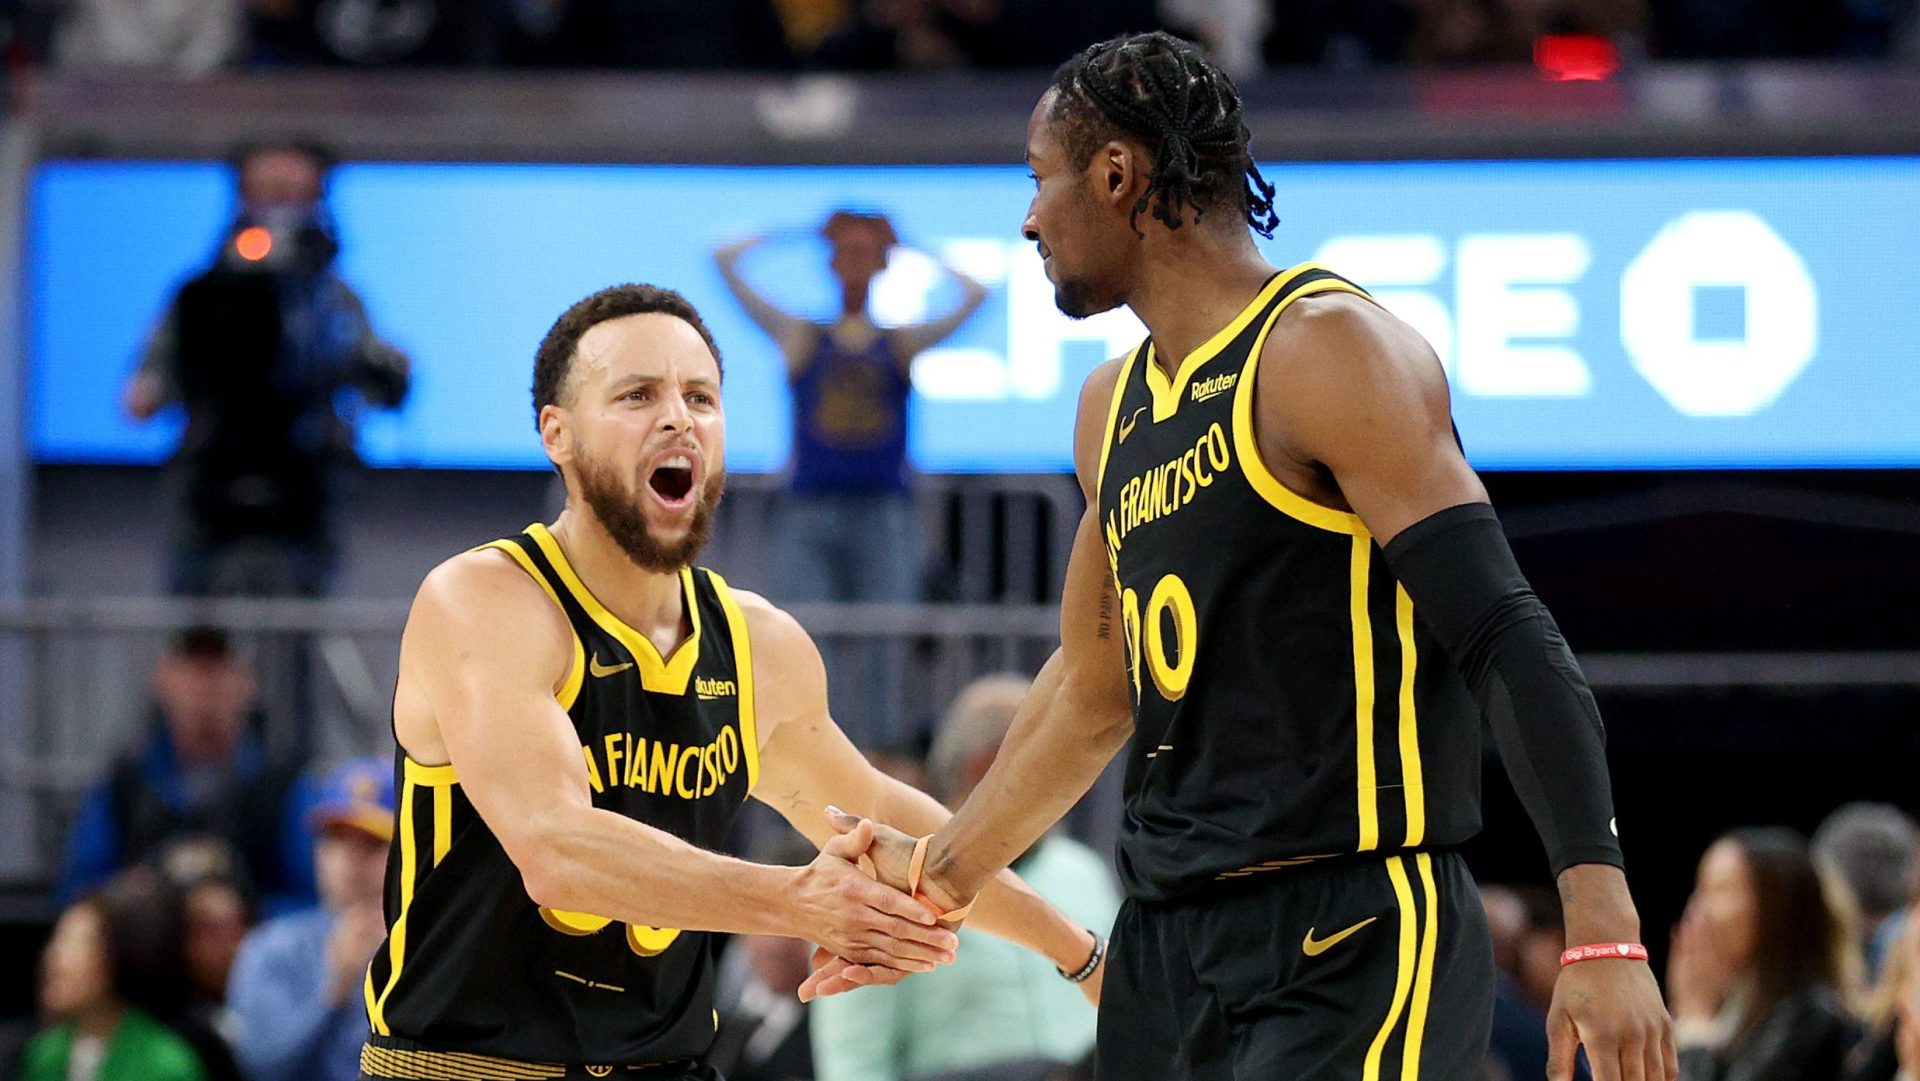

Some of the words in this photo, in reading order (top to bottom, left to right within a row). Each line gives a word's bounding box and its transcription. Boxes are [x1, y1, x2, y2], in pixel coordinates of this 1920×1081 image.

[868, 233, 1590, 398] CHSE
[1191, 373, 1238, 401] Rakuten
[1120, 422, 1230, 539] FRANCISCO
[695, 675, 736, 697] kuten
[1584, 946, 1616, 957] Bryant
